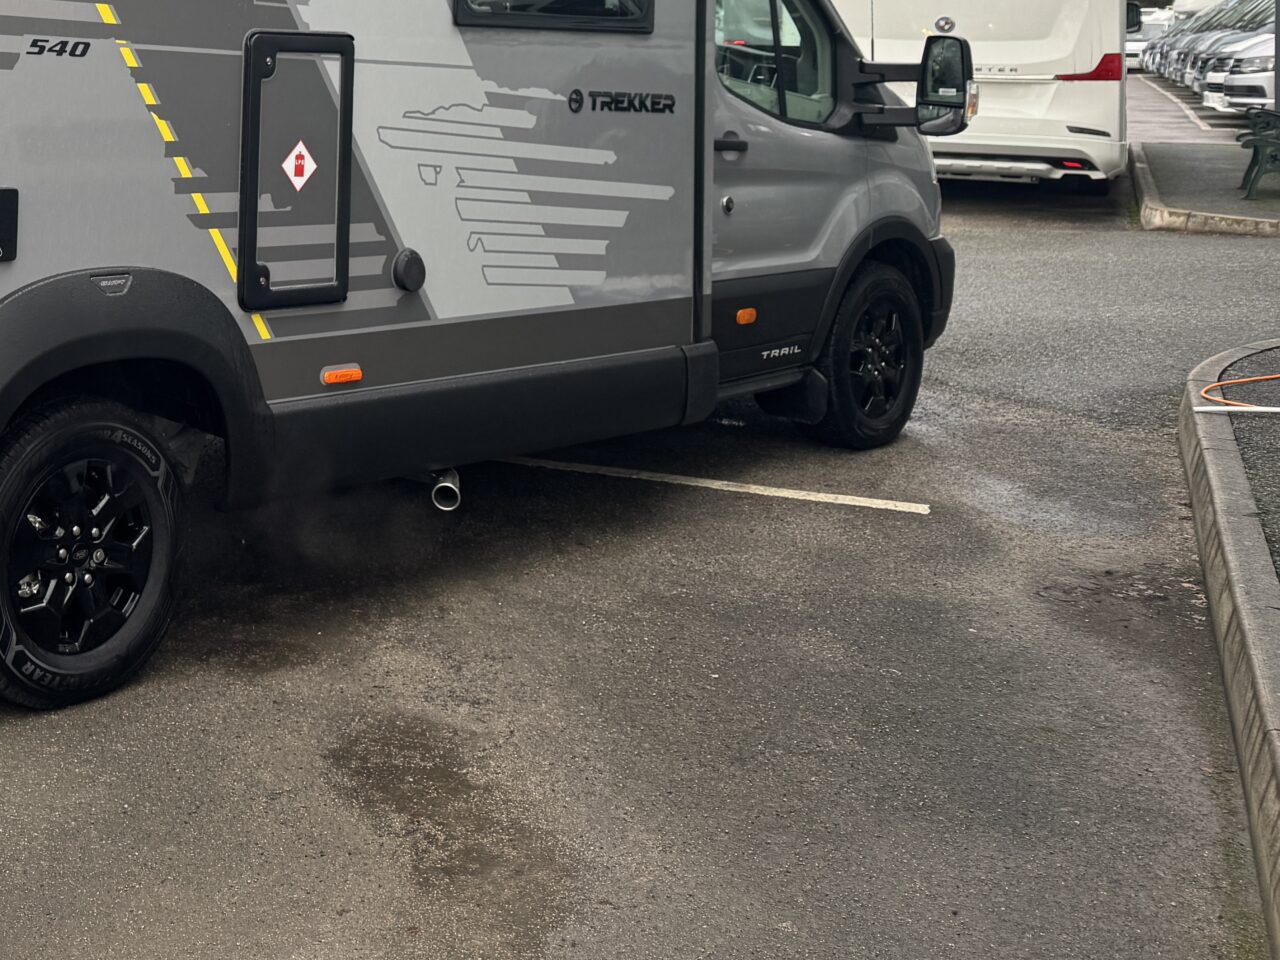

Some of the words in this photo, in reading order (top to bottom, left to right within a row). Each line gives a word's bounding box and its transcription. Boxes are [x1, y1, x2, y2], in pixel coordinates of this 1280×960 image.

[25, 38, 91, 58] 540
[588, 91, 676, 114] TREKKER
[761, 345, 802, 360] TRAIL
